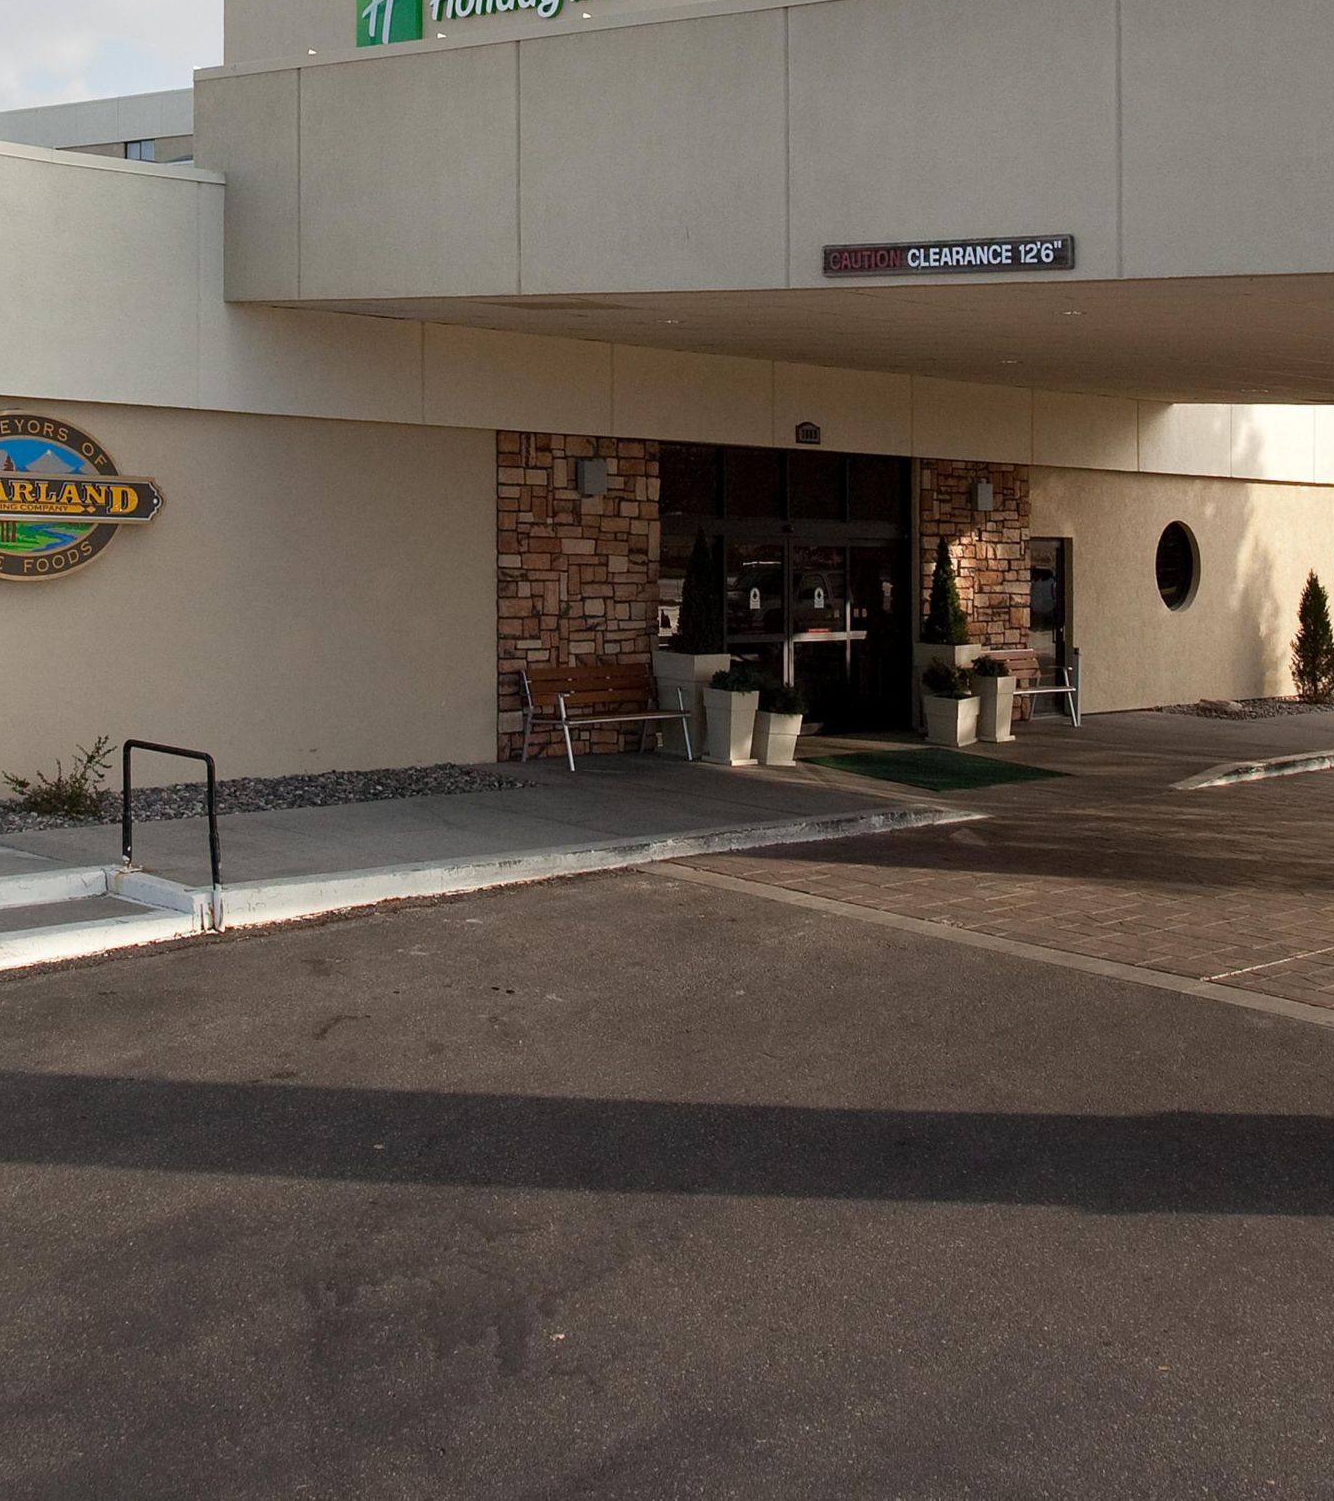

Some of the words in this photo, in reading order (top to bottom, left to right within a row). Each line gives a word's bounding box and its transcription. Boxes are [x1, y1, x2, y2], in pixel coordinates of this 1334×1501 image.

[829, 250, 901, 270] CAUTION
[906, 245, 1012, 268] CLEARANCE
[1018, 240, 1063, 264] 12'6"
[82, 441, 108, 468] OF
[19, 502, 70, 513] COMPANY
[23, 540, 93, 574] FOODS
